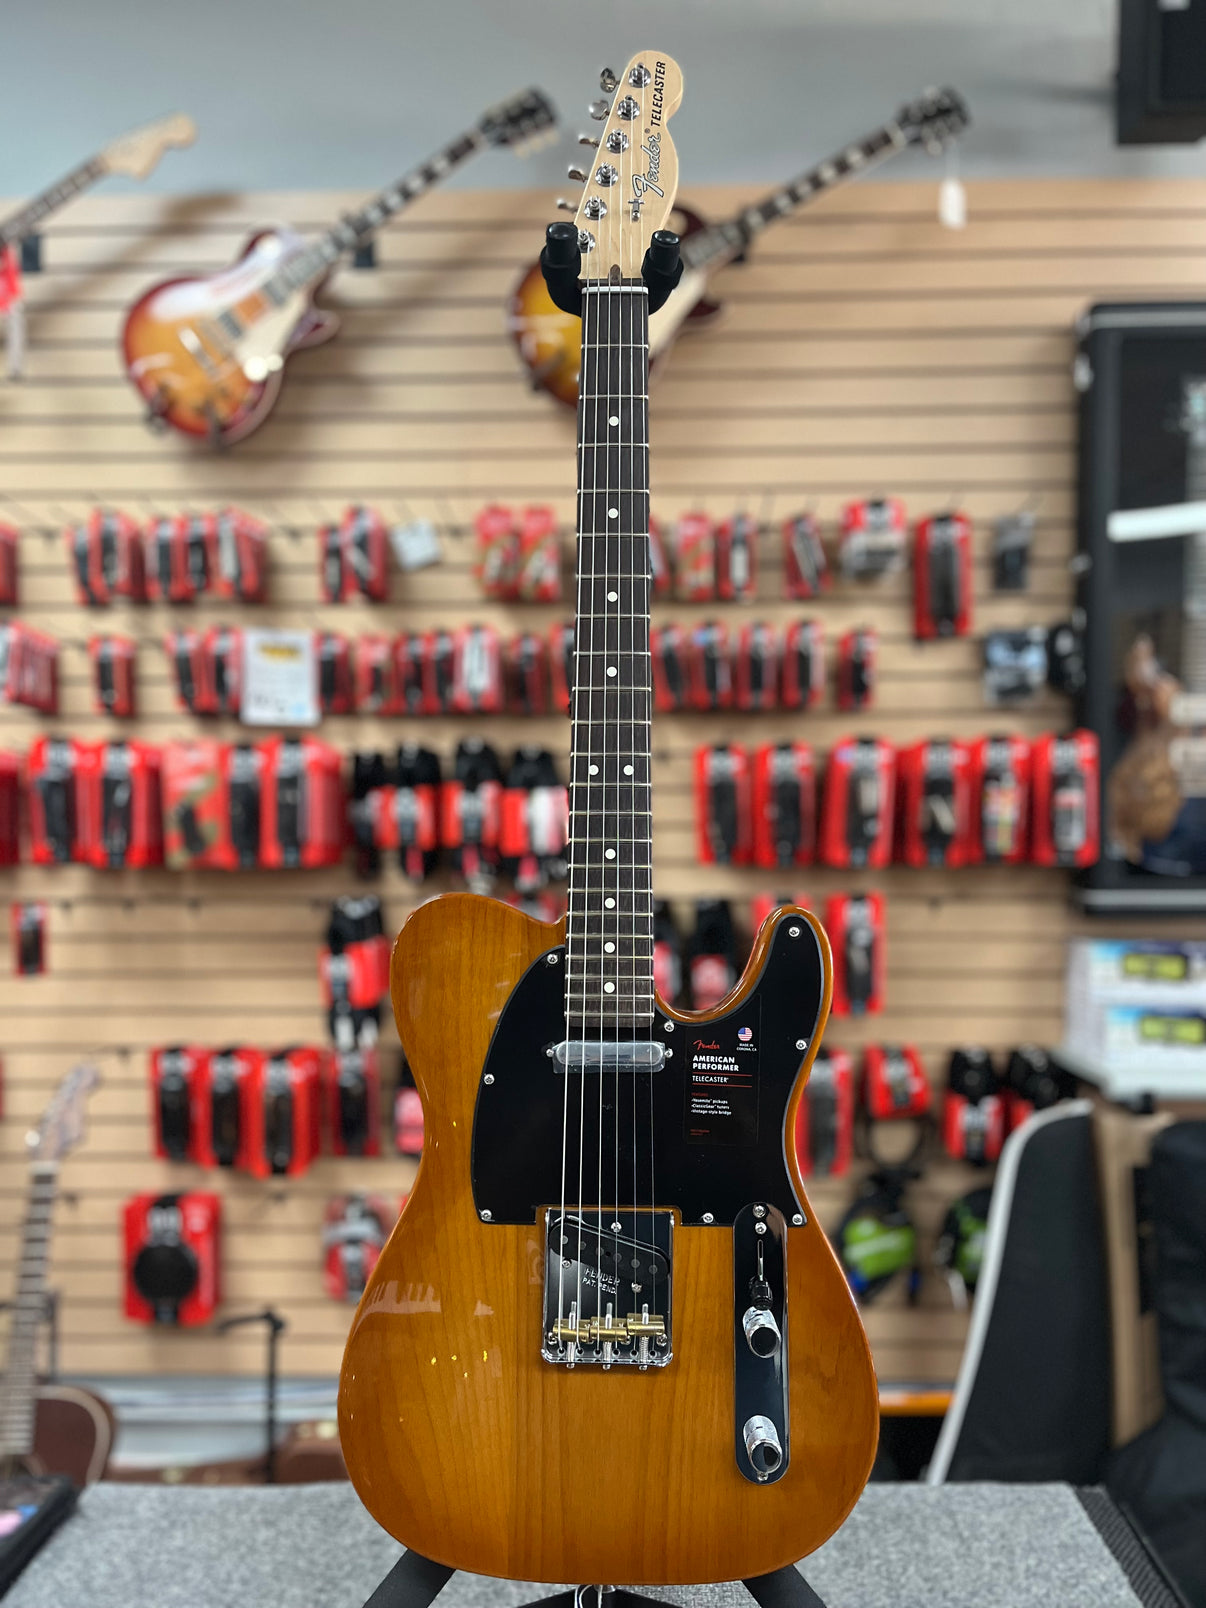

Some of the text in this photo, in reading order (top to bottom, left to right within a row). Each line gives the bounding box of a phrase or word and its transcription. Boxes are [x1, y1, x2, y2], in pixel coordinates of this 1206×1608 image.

[650, 61, 666, 127] TELECASTER
[692, 1055, 735, 1063] AMERICAN
[692, 1063, 739, 1072] PERFORMER
